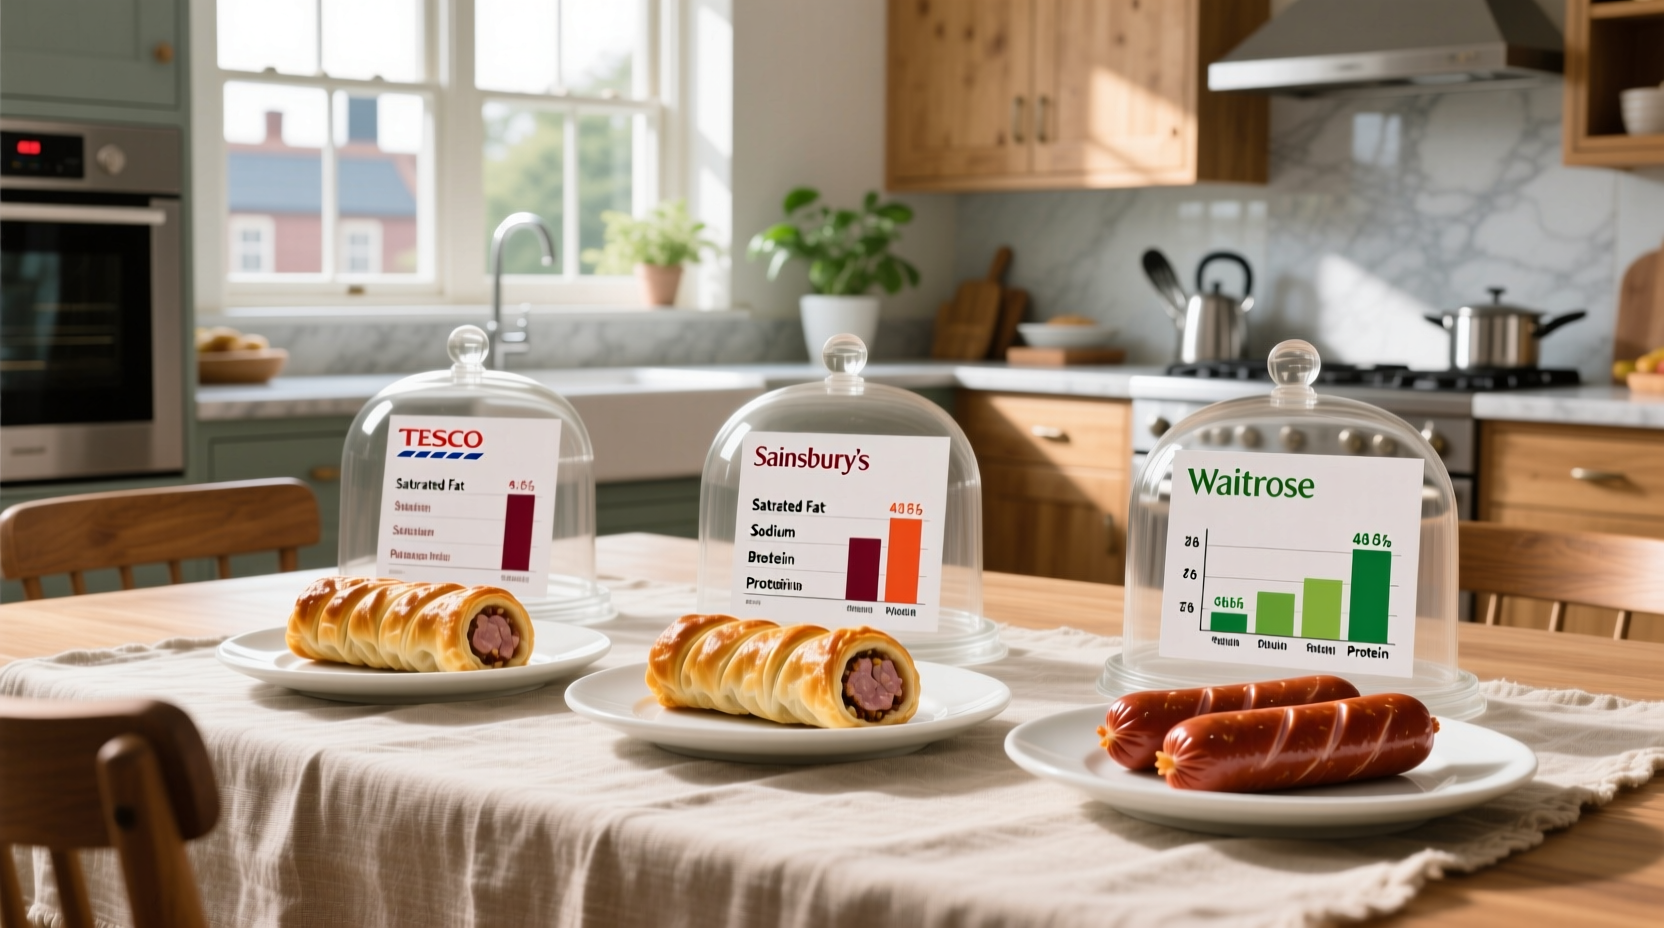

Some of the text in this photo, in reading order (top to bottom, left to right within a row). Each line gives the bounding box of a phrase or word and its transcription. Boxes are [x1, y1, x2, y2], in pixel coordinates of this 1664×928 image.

[398, 428, 484, 449] TESCO
[753, 445, 870, 476] Sainsbury's
[448, 478, 465, 491] Fat
[1187, 467, 1315, 499] Waitrose
[806, 500, 827, 514] Fat
[750, 523, 796, 538] Sodium
[1347, 645, 1390, 660] Protein
